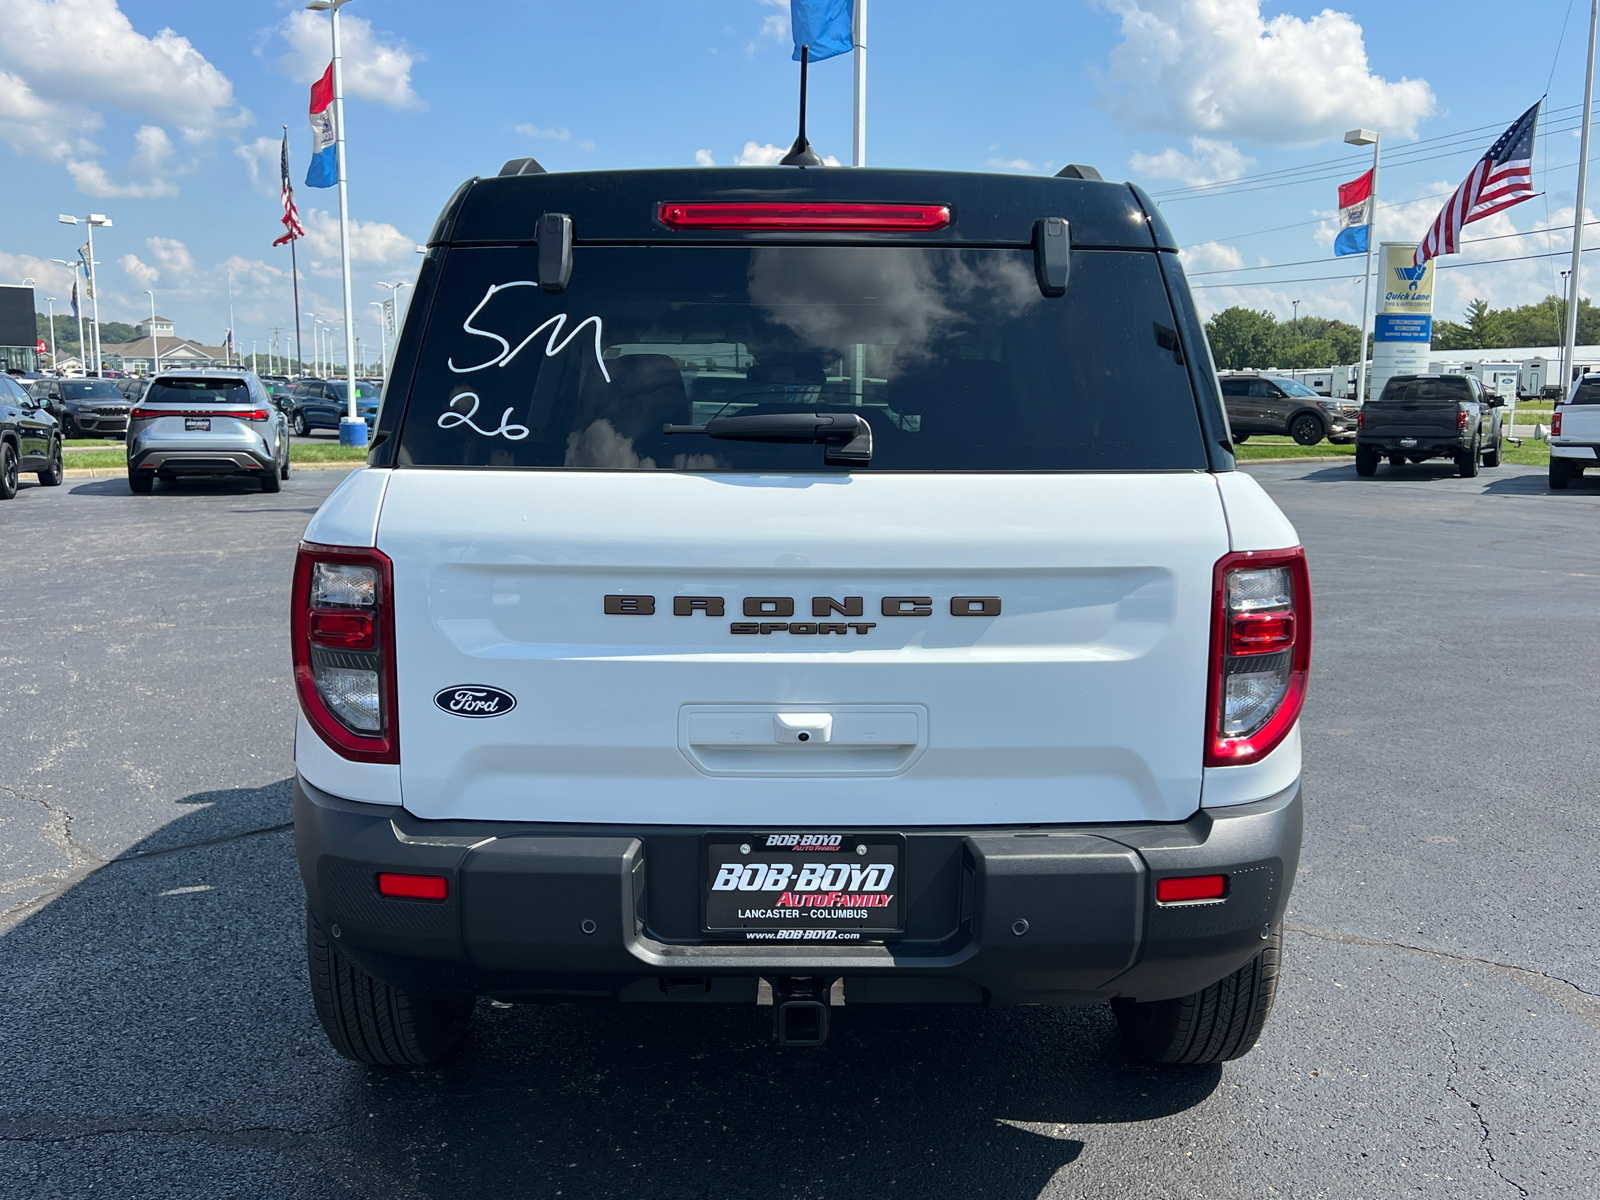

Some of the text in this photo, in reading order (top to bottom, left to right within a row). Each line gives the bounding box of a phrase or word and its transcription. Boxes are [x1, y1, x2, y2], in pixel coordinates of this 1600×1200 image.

[1386, 291, 1430, 301] Quick Lane
[437, 392, 530, 441] 26
[604, 594, 1002, 618] BRONCO
[730, 622, 877, 635] SPORT
[449, 690, 500, 712] Ford
[711, 863, 895, 892] BOB-BOYD
[738, 909, 800, 918] LANCASTER
[810, 909, 868, 918] COLUMBUS
